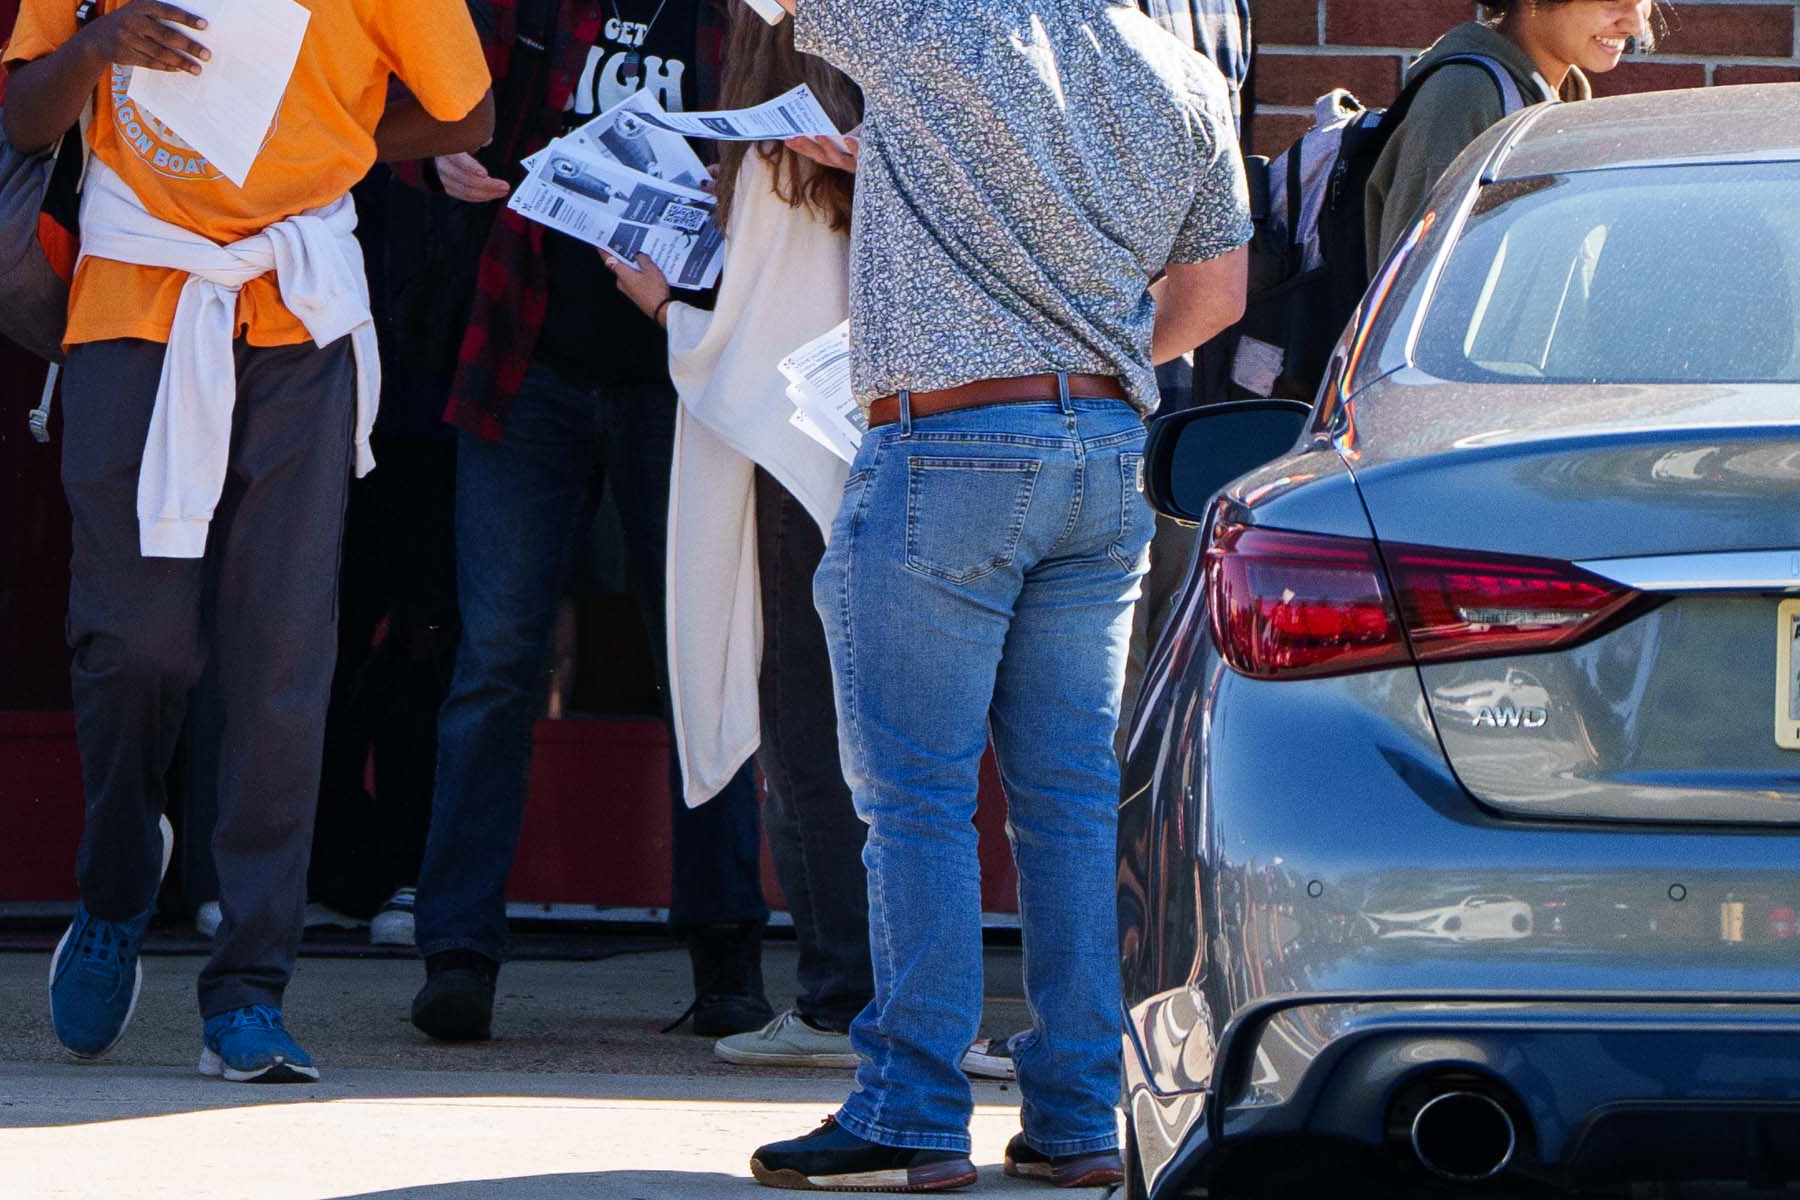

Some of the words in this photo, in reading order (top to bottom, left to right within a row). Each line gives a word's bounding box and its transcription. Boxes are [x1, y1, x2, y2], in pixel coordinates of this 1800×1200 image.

[564, 45, 685, 115] IGH
[153, 147, 208, 175] BOAT
[1472, 705, 1548, 728] AWD
